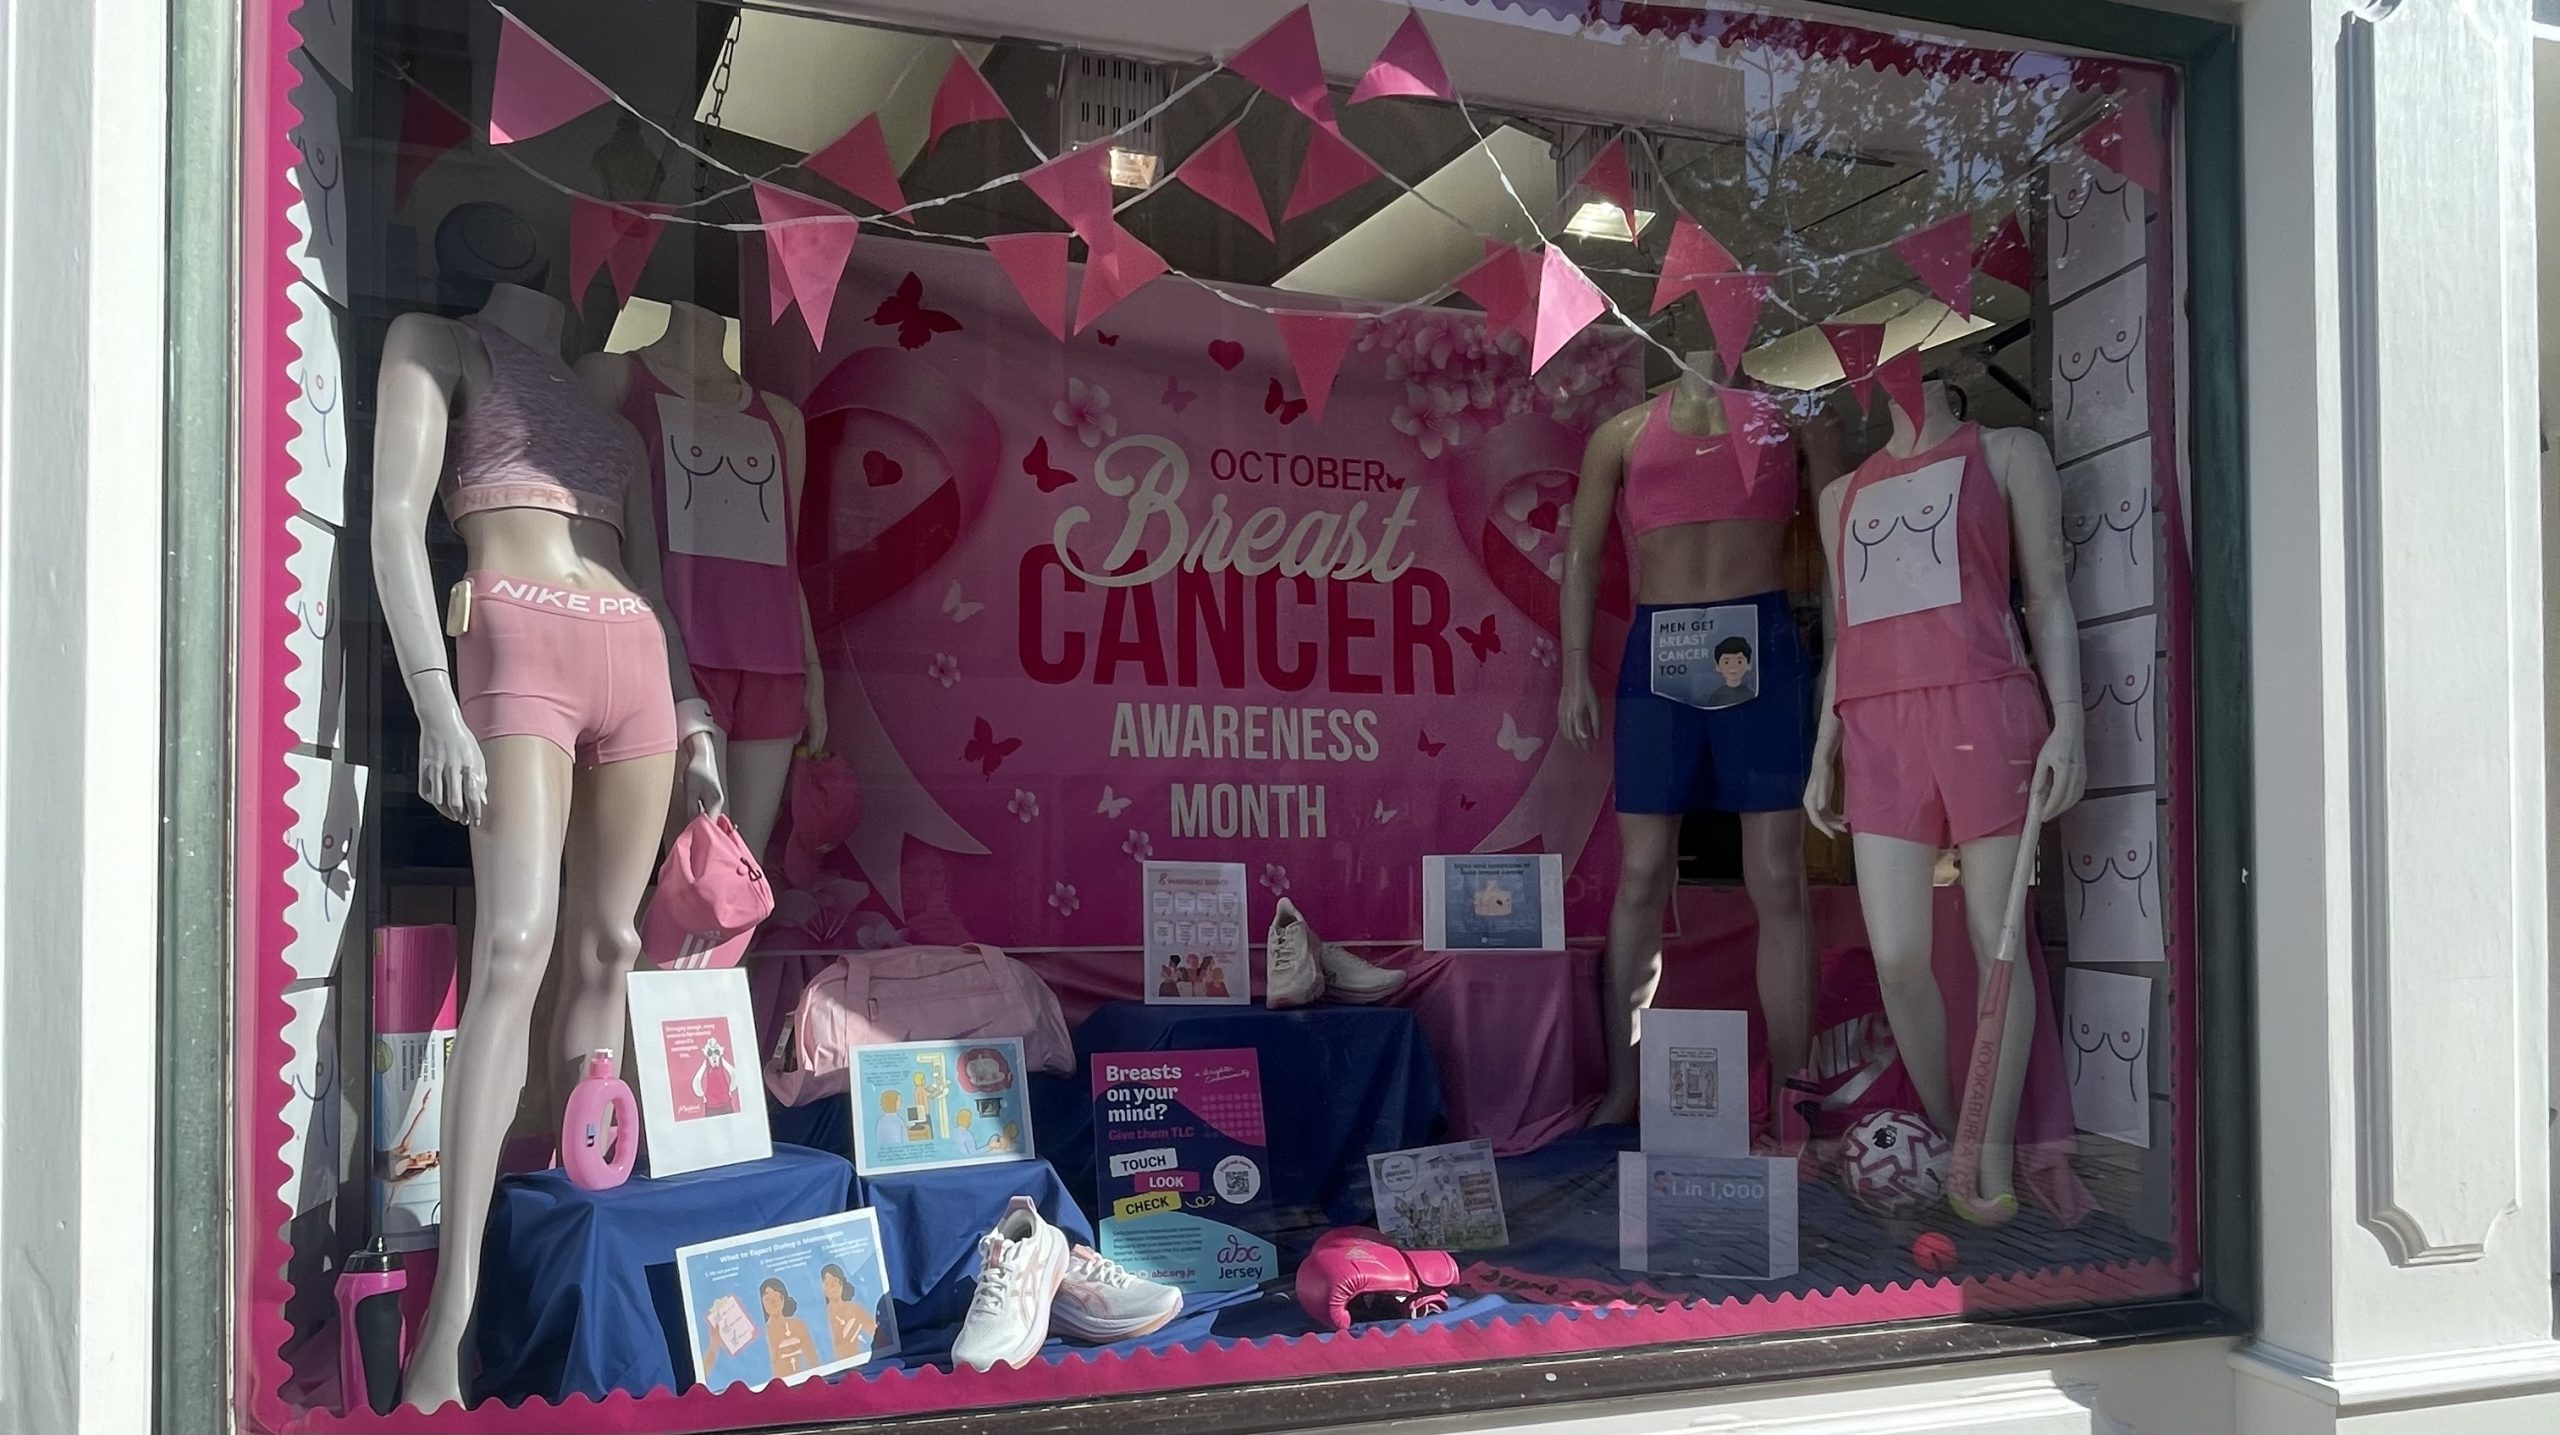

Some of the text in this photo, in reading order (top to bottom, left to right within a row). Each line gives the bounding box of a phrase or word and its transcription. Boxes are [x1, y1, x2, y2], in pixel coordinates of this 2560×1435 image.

[1211, 448, 1386, 492] OCTOBER
[1054, 434, 1420, 587] Breast
[490, 579, 593, 613] NIKE
[1018, 543, 1455, 695] CANCER
[1660, 620, 1714, 633] MEN GET
[1659, 634, 1708, 648] BREAST
[1659, 648, 1709, 662] CANCER
[1659, 664, 1688, 676] TOO
[1109, 702, 1380, 762] AWARENESS
[1171, 783, 1326, 839] MONTH
[1106, 1064, 1182, 1082] Breasts
[1106, 1085, 1179, 1107] on your
[1108, 1103, 1168, 1122] mind?
[1108, 1126, 1194, 1141] Give them TLC
[1121, 1155, 1166, 1172] TOUCH
[1149, 1176, 1184, 1188] LOOK
[1686, 1180, 1702, 1197] in
[1711, 1182, 1765, 1200] 1,000
[1126, 1196, 1169, 1214] CHECK
[1217, 1234, 1262, 1263] abc
[1218, 1265, 1262, 1280] Jersey
